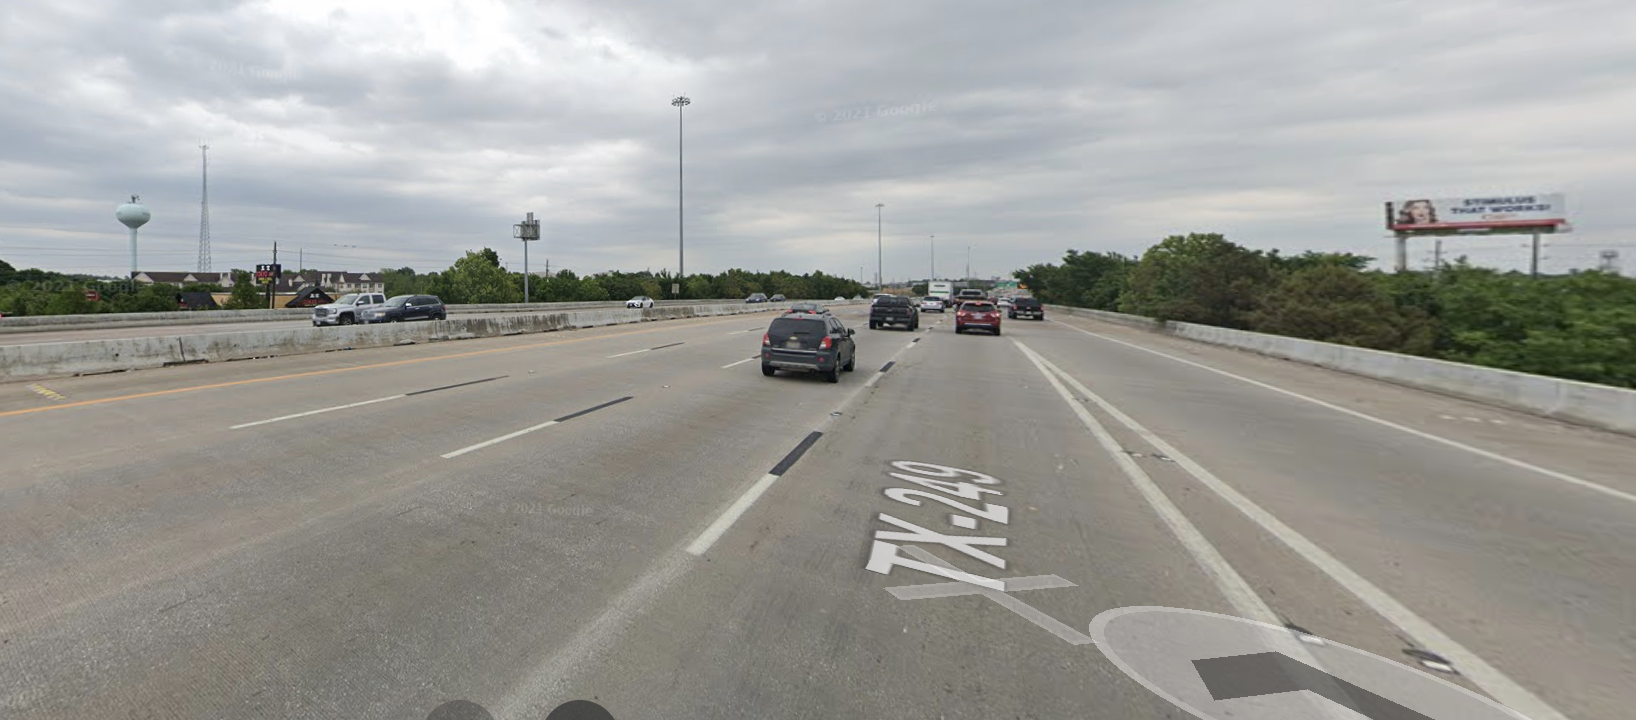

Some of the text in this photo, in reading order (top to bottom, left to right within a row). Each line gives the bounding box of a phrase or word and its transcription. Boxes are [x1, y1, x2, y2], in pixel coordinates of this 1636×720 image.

[1464, 196, 1535, 206] STIMULUS
[1451, 203, 1550, 215] THAT WORKS!
